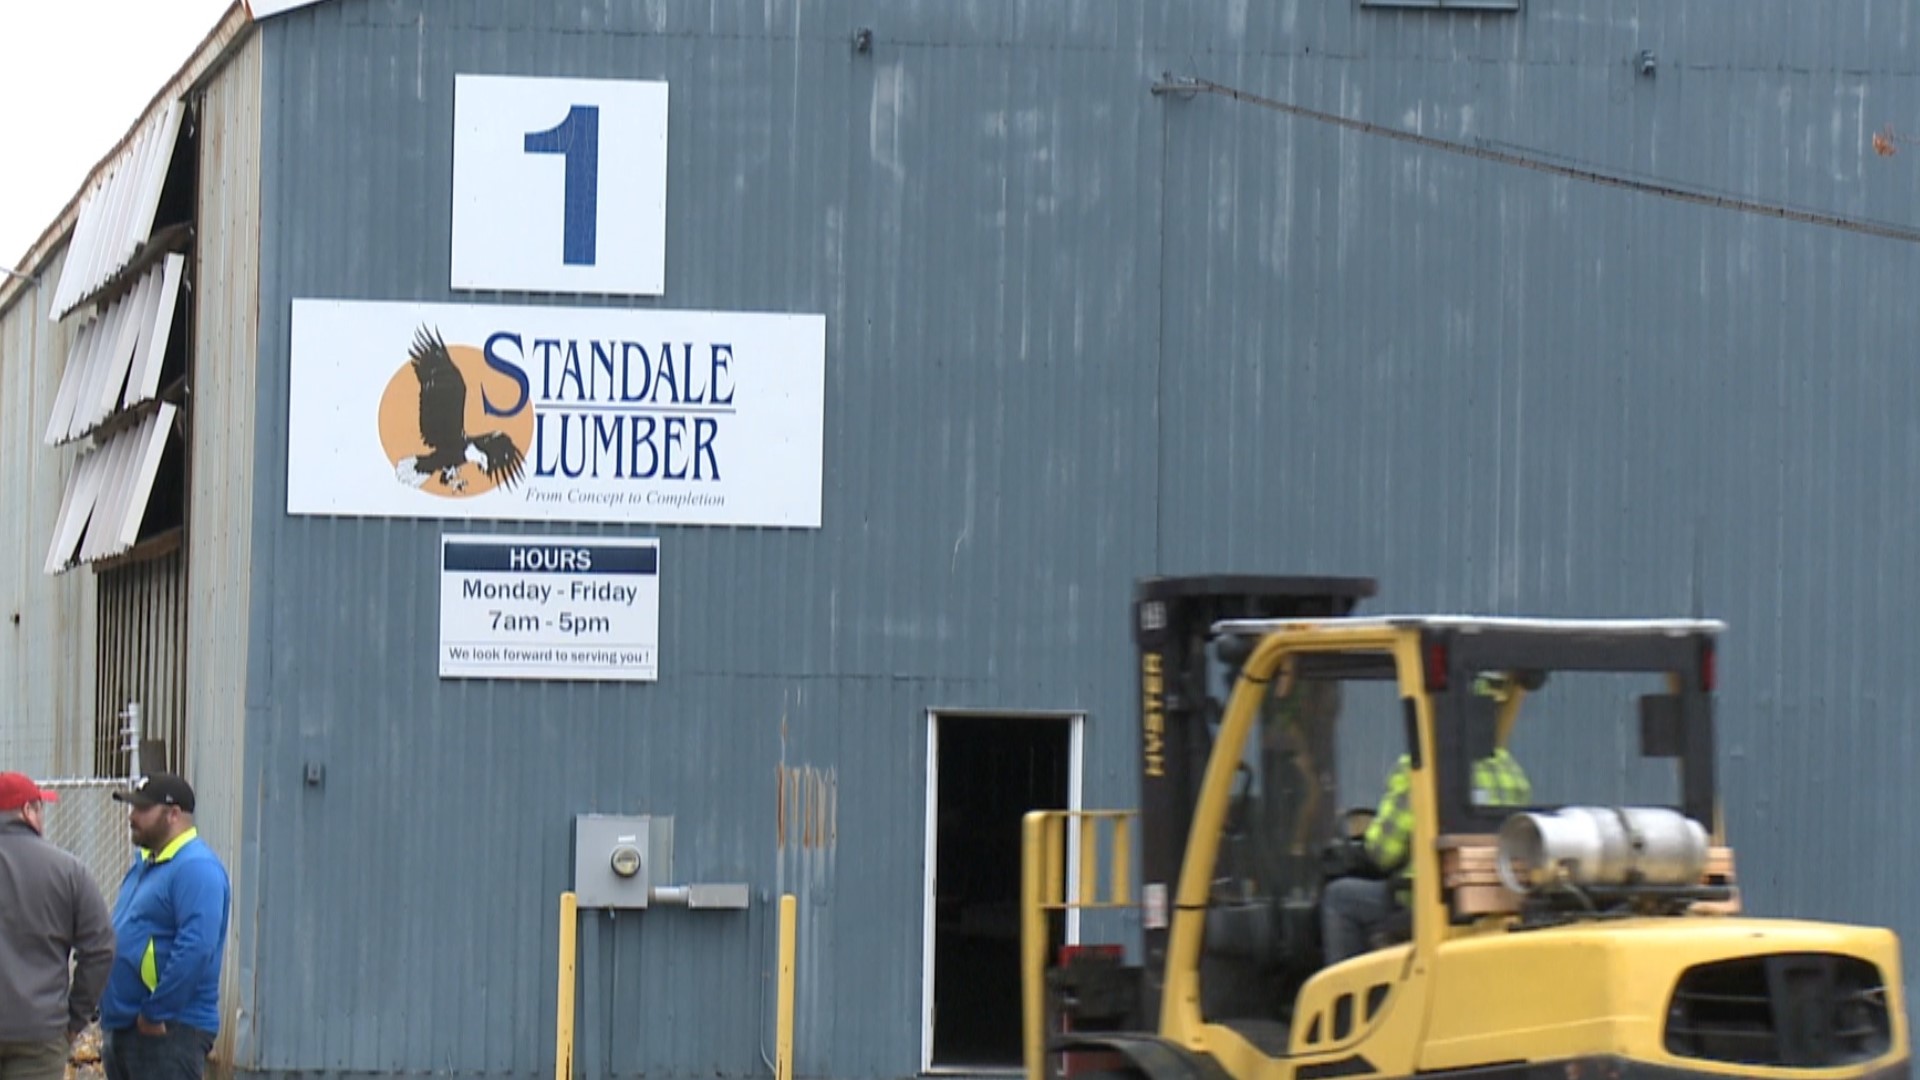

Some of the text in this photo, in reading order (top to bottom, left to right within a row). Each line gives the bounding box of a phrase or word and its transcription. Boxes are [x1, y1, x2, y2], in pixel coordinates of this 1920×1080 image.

[524, 105, 599, 266] 1
[480, 331, 736, 417] STANDALE
[533, 413, 722, 481] LUMBER
[525, 487, 725, 508] From Concept to Completion
[509, 547, 592, 571] HOURS
[462, 578, 551, 605] Monday
[570, 580, 637, 606] Friday
[488, 611, 539, 632] 7am
[558, 612, 610, 636] 5pm
[449, 647, 470, 661] We
[473, 647, 500, 661] look
[503, 648, 552, 662] forward
[555, 649, 568, 662] to
[571, 650, 617, 665] serving
[1142, 652, 1165, 777] HYSTER
